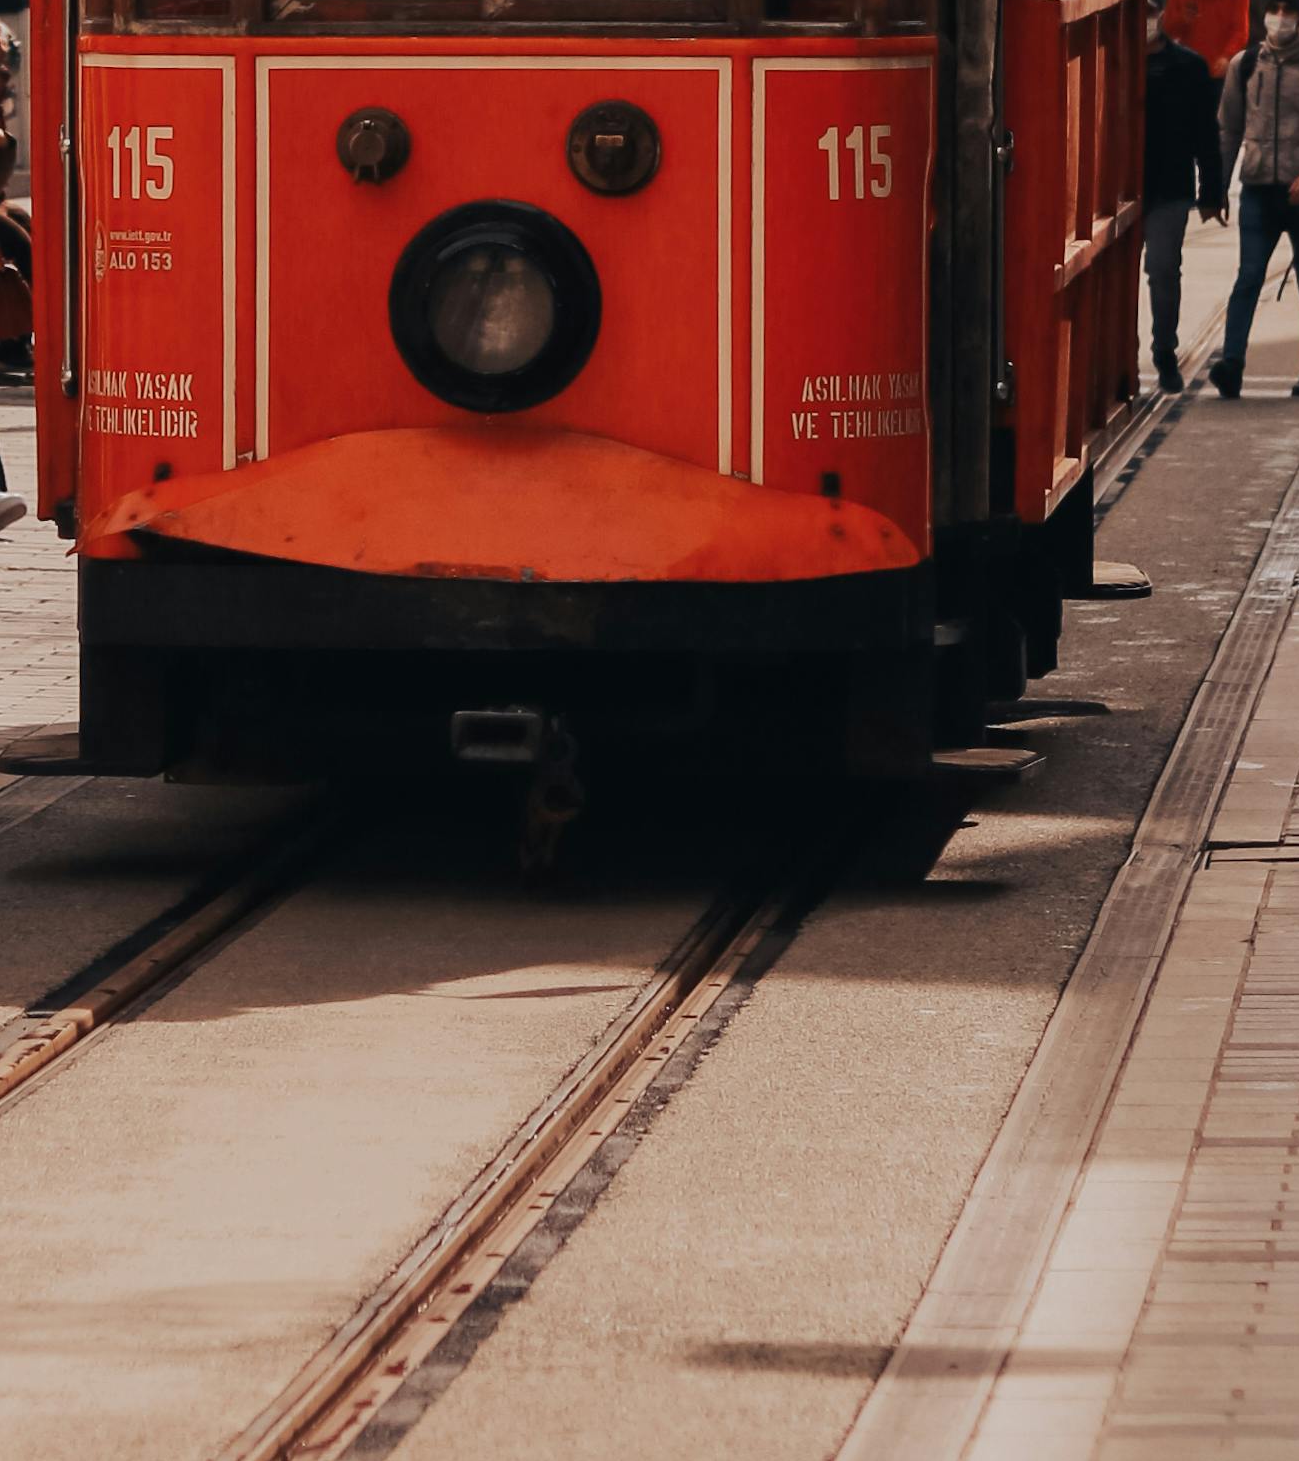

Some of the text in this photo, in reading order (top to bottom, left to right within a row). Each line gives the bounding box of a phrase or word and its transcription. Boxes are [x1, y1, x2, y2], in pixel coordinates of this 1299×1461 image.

[107, 126, 174, 200] 115
[818, 125, 892, 200] 115
[109, 251, 137, 270] ALO
[141, 252, 173, 271] 153
[134, 372, 193, 401] YASAK
[792, 412, 819, 439] VE
